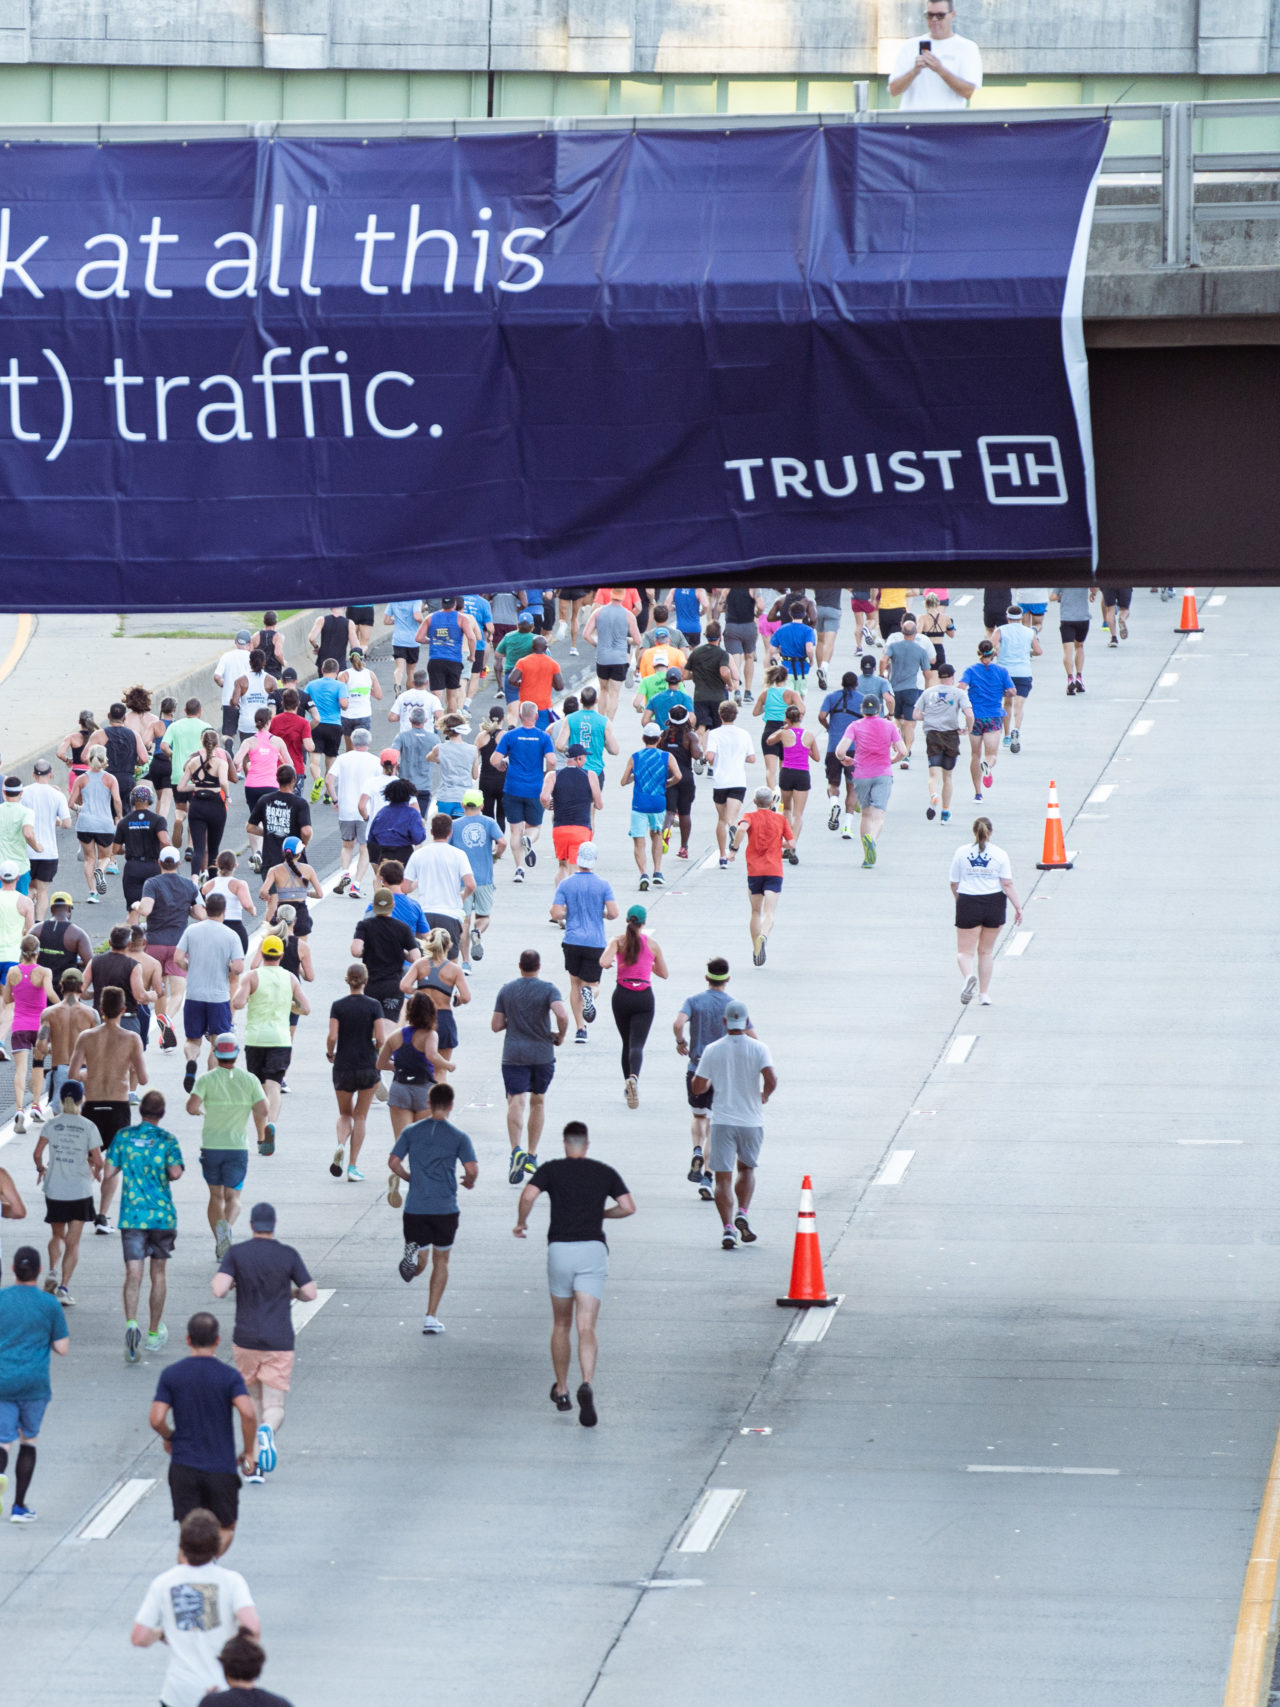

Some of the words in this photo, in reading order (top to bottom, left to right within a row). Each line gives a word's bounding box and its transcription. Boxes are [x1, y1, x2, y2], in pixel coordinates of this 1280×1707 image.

[74, 215, 180, 300] at
[204, 203, 322, 299] all
[354, 203, 548, 296] this
[103, 346, 444, 444] traffic.
[724, 450, 962, 501] TRUIST
